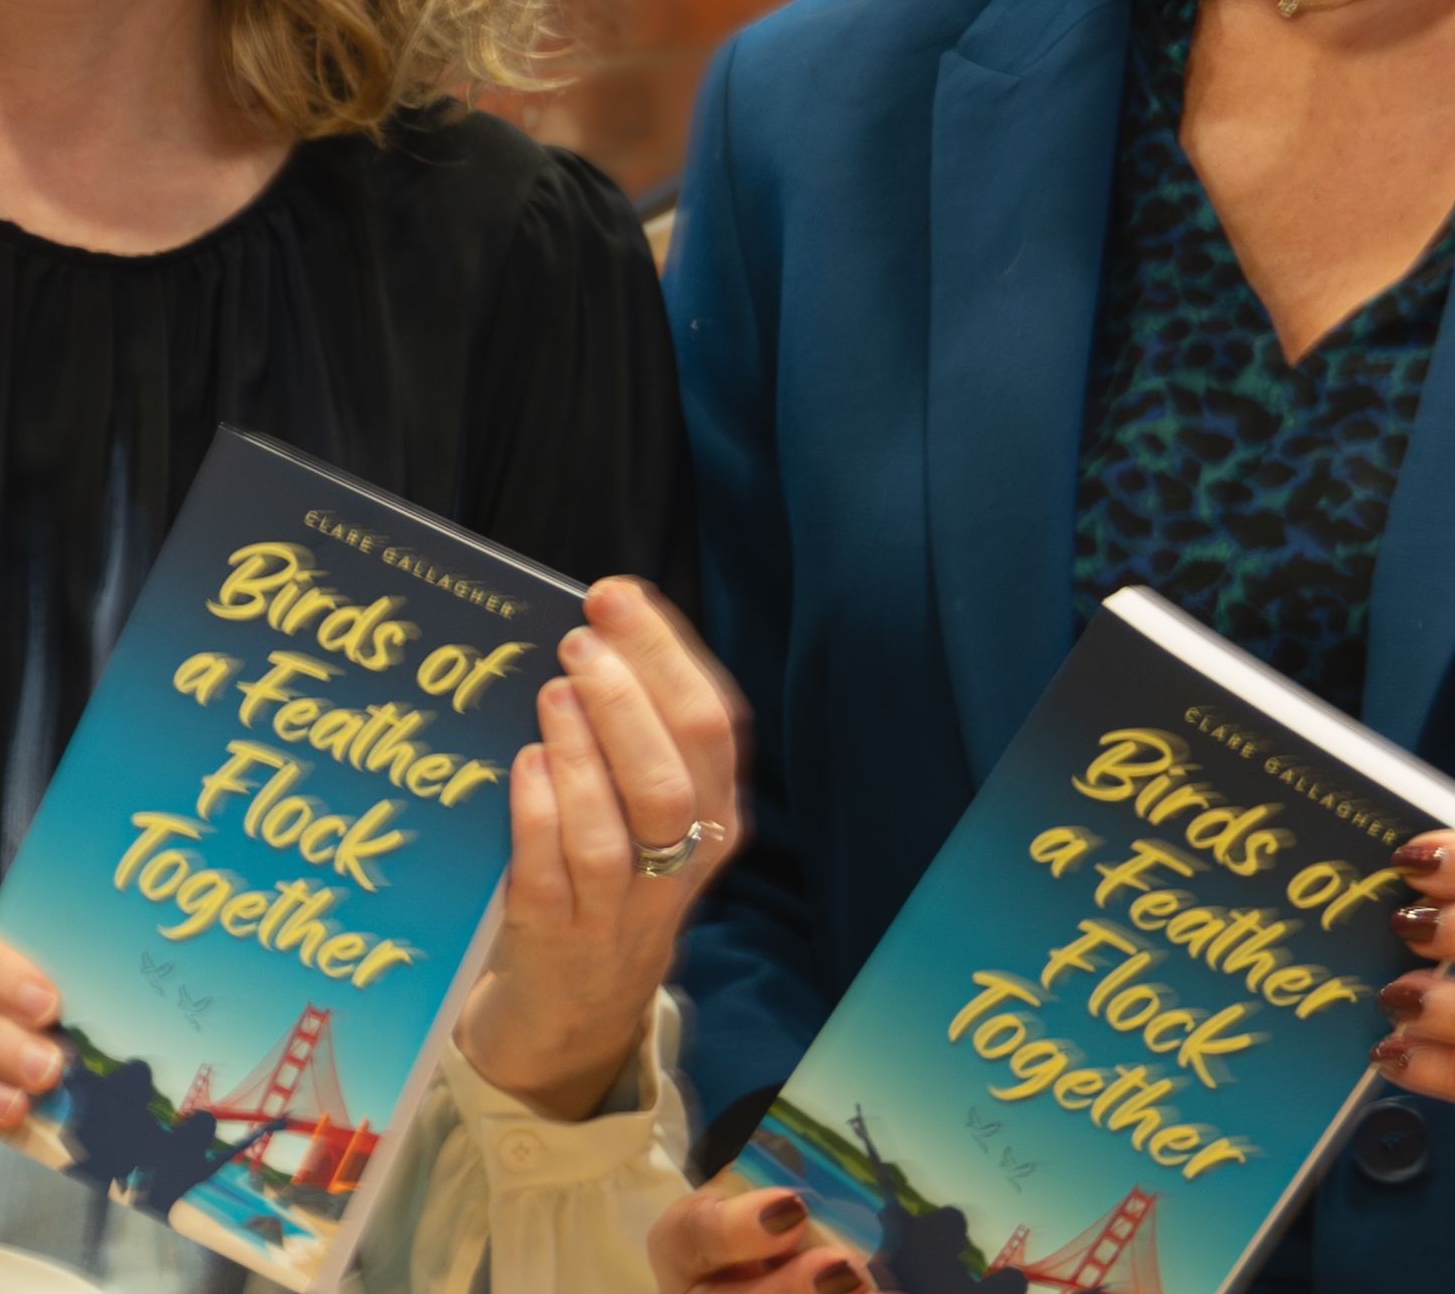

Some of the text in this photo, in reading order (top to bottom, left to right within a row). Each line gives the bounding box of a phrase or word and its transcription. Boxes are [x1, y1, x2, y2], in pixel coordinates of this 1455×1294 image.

[206, 541, 538, 713] Birds of
[303, 510, 522, 620] CLARE GALLAGHER
[174, 646, 504, 807] a Feather
[1184, 707, 1404, 845] CLARE GALLAGHER
[112, 809, 426, 989] Together
[196, 740, 416, 893] Flock
[1072, 726, 1408, 931] Birds of
[1030, 820, 1375, 1020] a Feather
[1039, 918, 1270, 1088] Flock
[947, 968, 1260, 1181] Together
